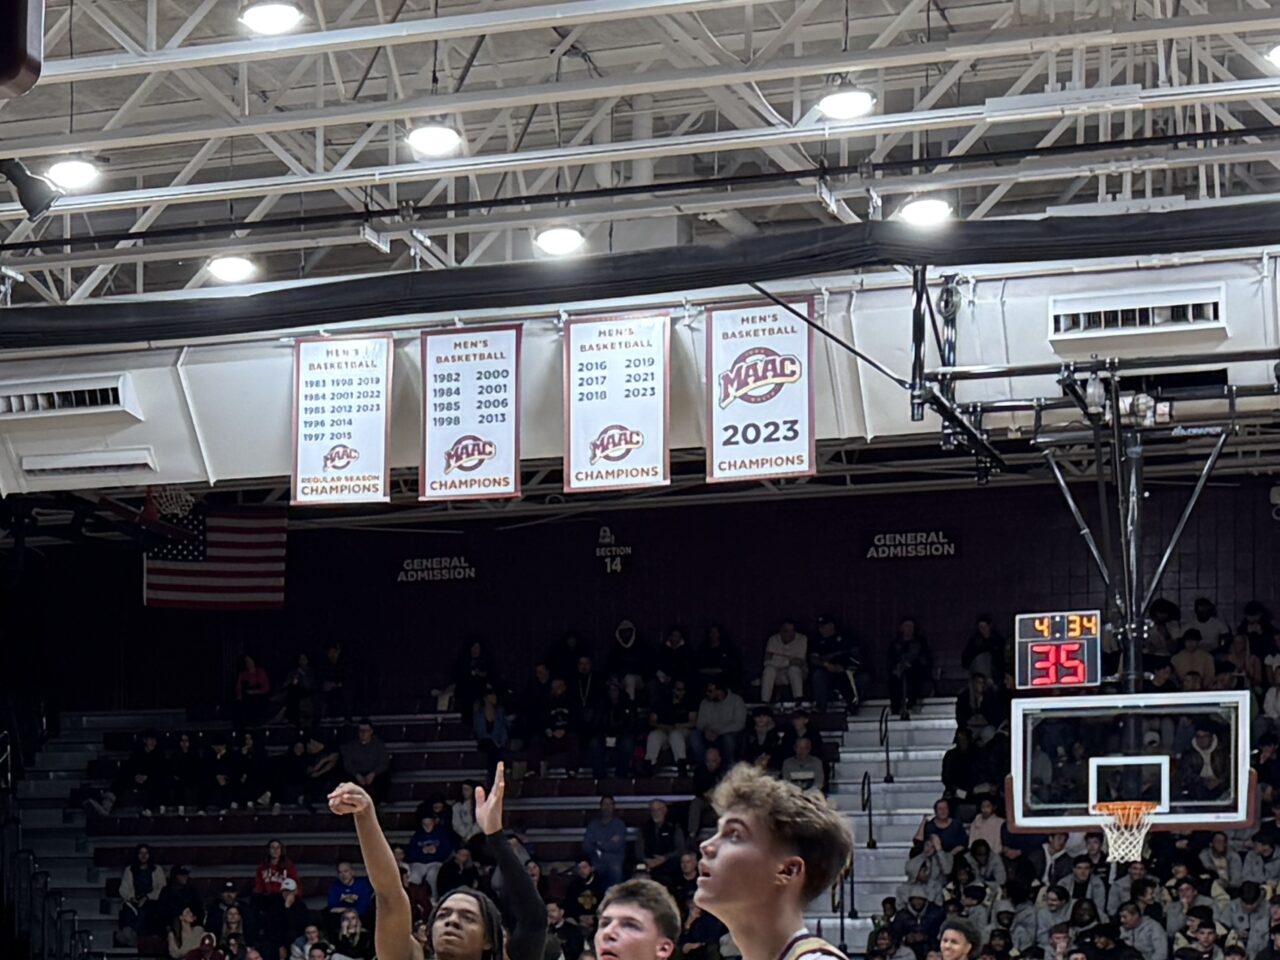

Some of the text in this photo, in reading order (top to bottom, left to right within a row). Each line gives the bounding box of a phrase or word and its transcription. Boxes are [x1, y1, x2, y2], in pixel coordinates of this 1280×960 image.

[740, 313, 779, 325] MEN'S
[722, 325, 798, 340] BASKETBALL
[453, 339, 488, 350] MEN'S
[580, 339, 653, 352] BASKETBALL
[436, 352, 507, 364] BASKETBALL
[577, 357, 655, 372] 2016 2019
[433, 369, 510, 383] 1982 2000
[578, 372, 655, 387] 2017 2021
[721, 355, 799, 402] MAAC
[433, 384, 507, 398] 1984 2001
[578, 386, 656, 402] 2018 2023
[356, 404, 381, 413] 2023
[433, 398, 509, 412] 1985 2006
[330, 418, 353, 427] 2014
[433, 413, 506, 427] 1998 2013
[330, 432, 352, 441] 2015
[722, 419, 800, 447] 2023
[590, 430, 642, 464] MAAC
[444, 440, 496, 474] MAAC
[717, 454, 805, 472] CHAMPIONS
[344, 474, 380, 482] SEASON
[575, 466, 659, 482] CHAMPIONS
[301, 483, 380, 496] CHAMPIONS
[430, 476, 510, 491] CHAMPIONS
[873, 531, 948, 546] GENERAL
[595, 546, 632, 557] SECTION
[866, 543, 955, 558] ADMISSION
[403, 556, 469, 570] GENERAL
[604, 557, 622, 573] 14
[397, 567, 476, 582] ADMISSION
[1032, 643, 1085, 686] 35
